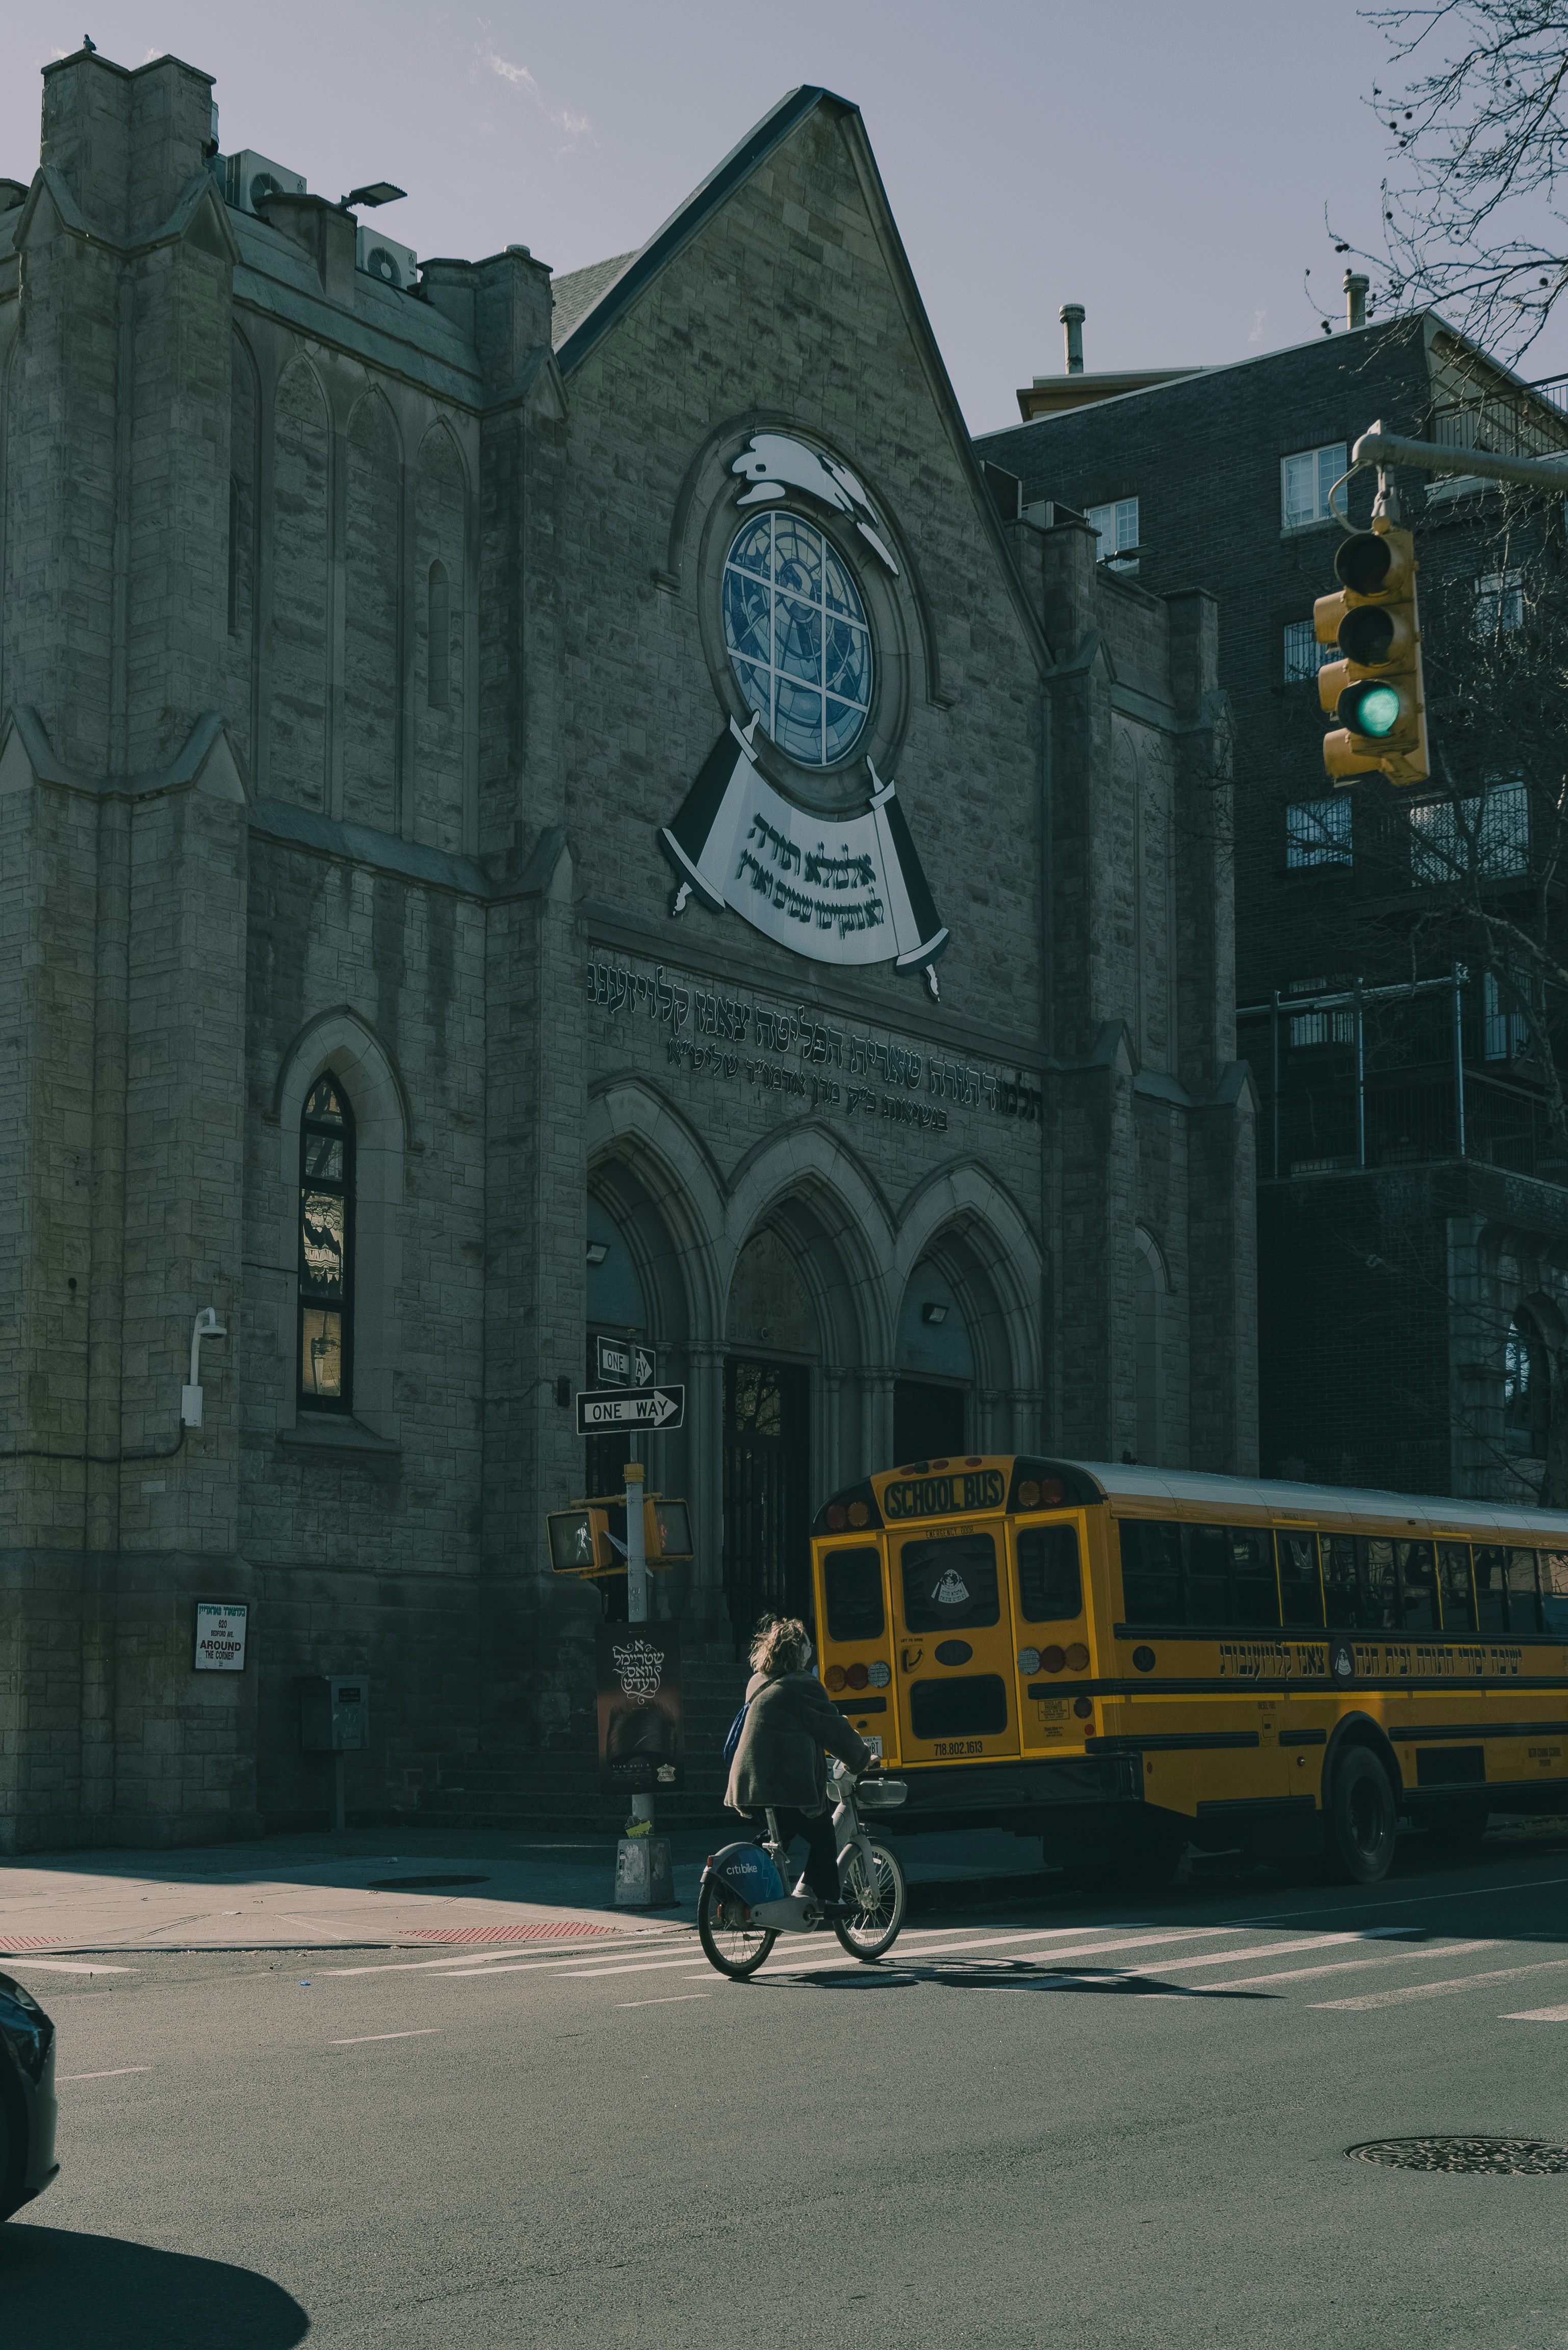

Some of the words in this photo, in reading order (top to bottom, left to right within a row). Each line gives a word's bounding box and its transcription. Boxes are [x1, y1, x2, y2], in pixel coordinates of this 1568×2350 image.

[747, 813, 801, 876] תורה
[736, 848, 774, 899] וארץ
[804, 841, 876, 890] אלמלא
[772, 879, 813, 923] שמים
[864, 886, 884, 929] לא
[815, 899, 865, 940] נתקיימו
[696, 990, 751, 1041] צאנז
[756, 1005, 844, 1068] הפליטה
[851, 1035, 922, 1089] שארית
[812, 1074, 840, 1106] מרן
[930, 1056, 981, 1106] תורה
[883, 1094, 948, 1132] בנשיאות
[607, 1353, 624, 1371] ONE
[636, 1360, 647, 1376] AY
[593, 1403, 622, 1420] ONE
[636, 1400, 668, 1417] WAY
[890, 1477, 960, 1516] SCHOOL
[964, 1473, 999, 1509] BUS
[926, 1527, 957, 1539] EMERGENCY
[961, 1525, 974, 1534] DOOR
[218, 1619, 227, 1628] 620
[200, 1640, 241, 1651] AROUND
[205, 1650, 214, 1659] THE
[216, 1651, 234, 1661] CORNER
[613, 1648, 664, 1666] שטריימל
[635, 1639, 644, 1652] א
[1138, 1649, 1151, 1668] 38
[1297, 1644, 1325, 1676] צאנז
[1385, 1646, 1412, 1676] ובית
[1417, 1646, 1454, 1676] התורה
[624, 1677, 657, 1692] רעדט
[627, 1665, 653, 1677] וואס
[934, 1741, 983, 1756] 718.802.1613
